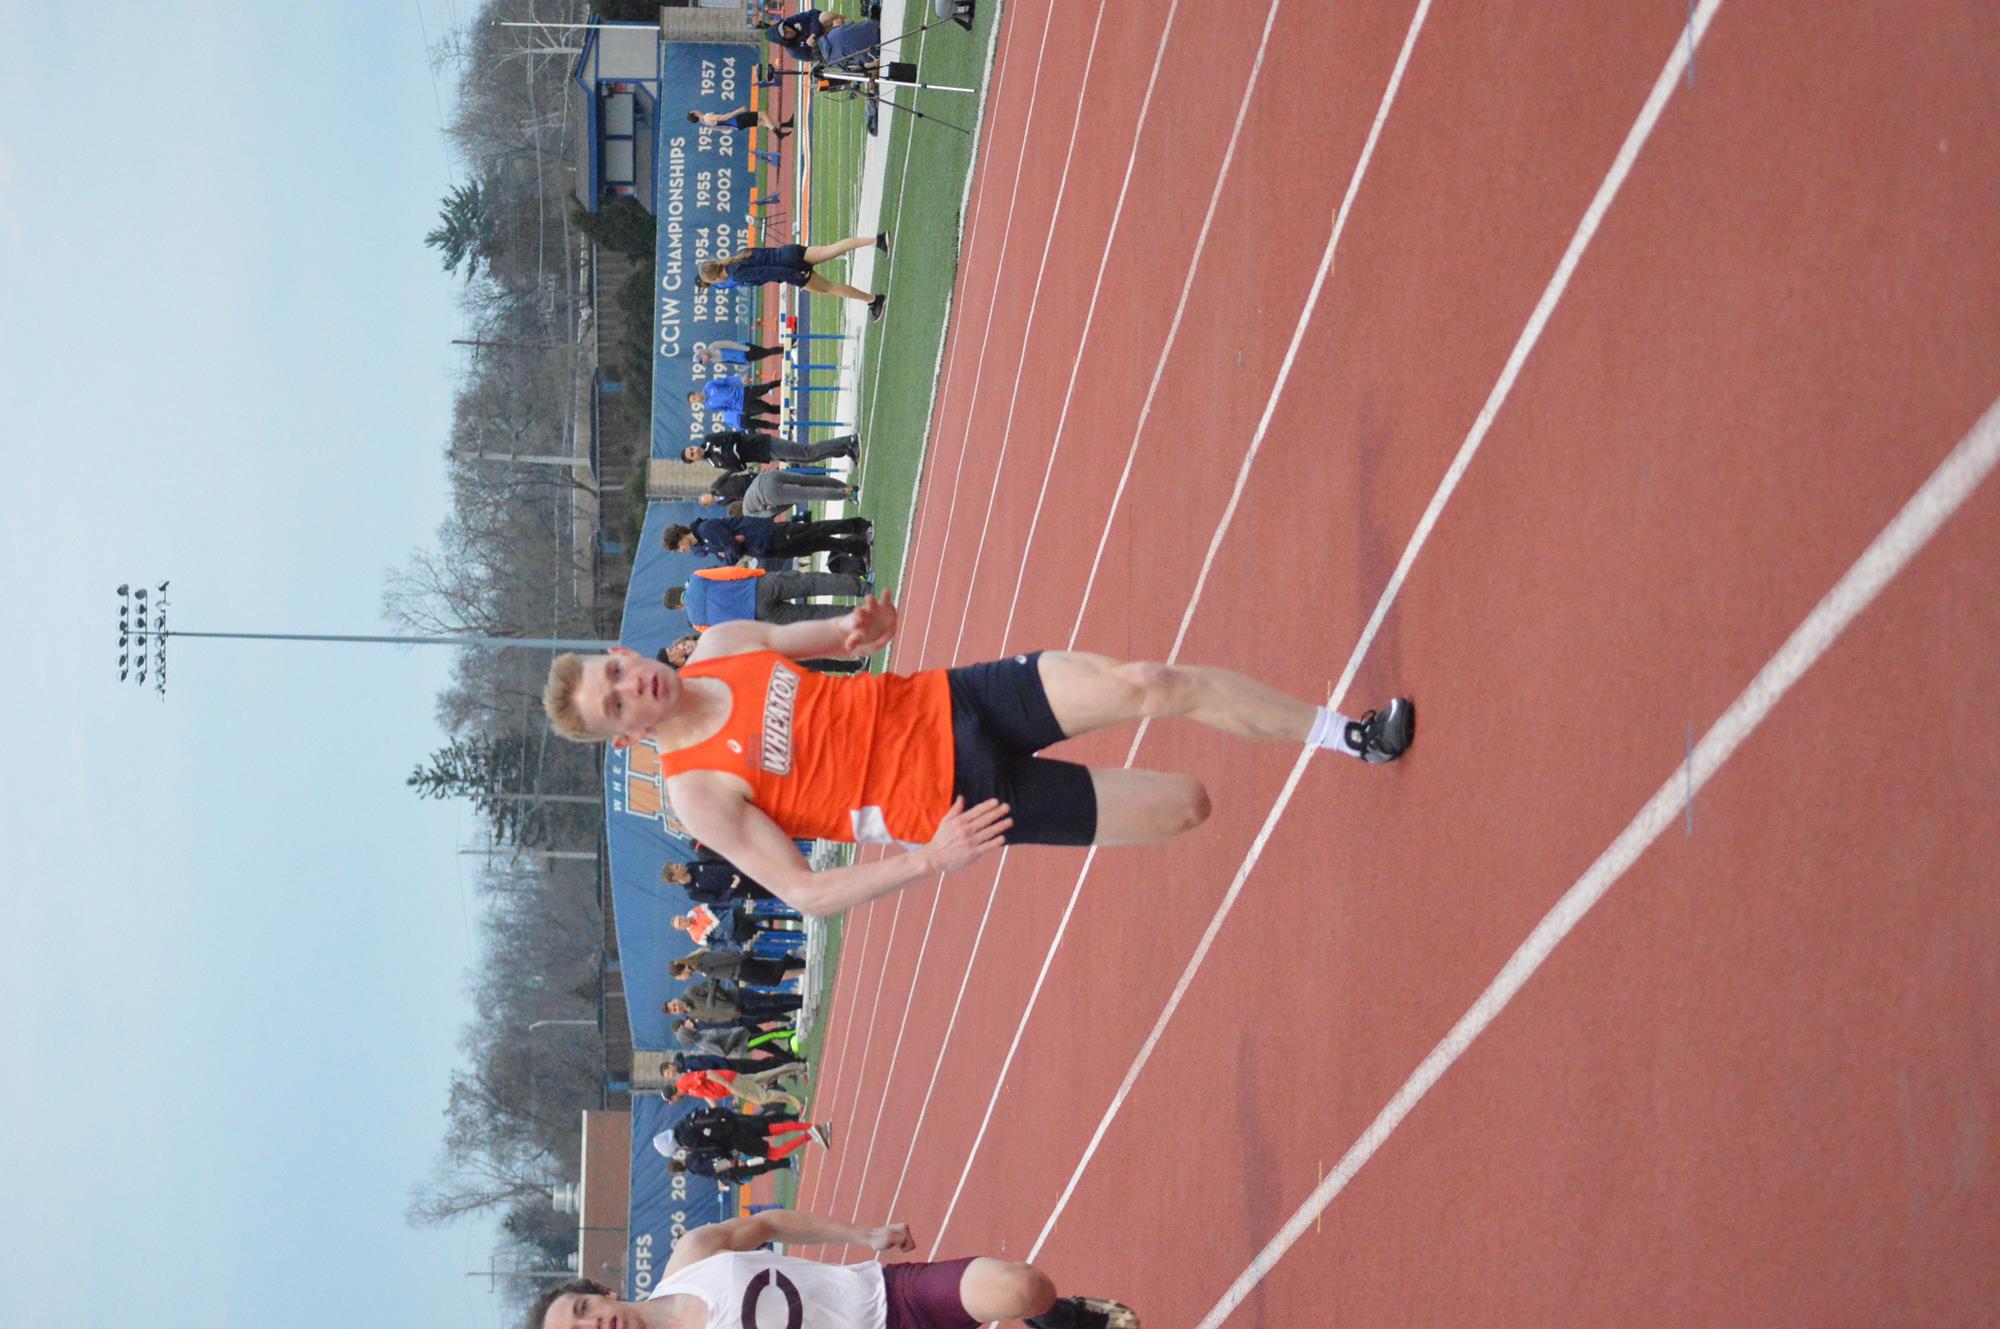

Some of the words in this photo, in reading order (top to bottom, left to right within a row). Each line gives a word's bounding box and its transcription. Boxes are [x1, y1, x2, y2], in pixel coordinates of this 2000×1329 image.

[700, 60, 716, 96] 1957
[721, 57, 735, 101] 2004
[698, 126, 712, 152] 195
[719, 129, 733, 157] 20
[696, 171, 711, 208] 1955
[717, 168, 731, 213] 2002
[662, 137, 686, 291] CHAMPIONSHIPS
[695, 227, 710, 265] 1954
[716, 223, 730, 259] 000
[660, 297, 681, 357] CCIW
[692, 341, 706, 381] 190
[690, 402, 704, 441] 1949
[764, 663, 796, 773] WHEATON
[671, 1149, 686, 1201] 206
[670, 1211, 685, 1249] 06
